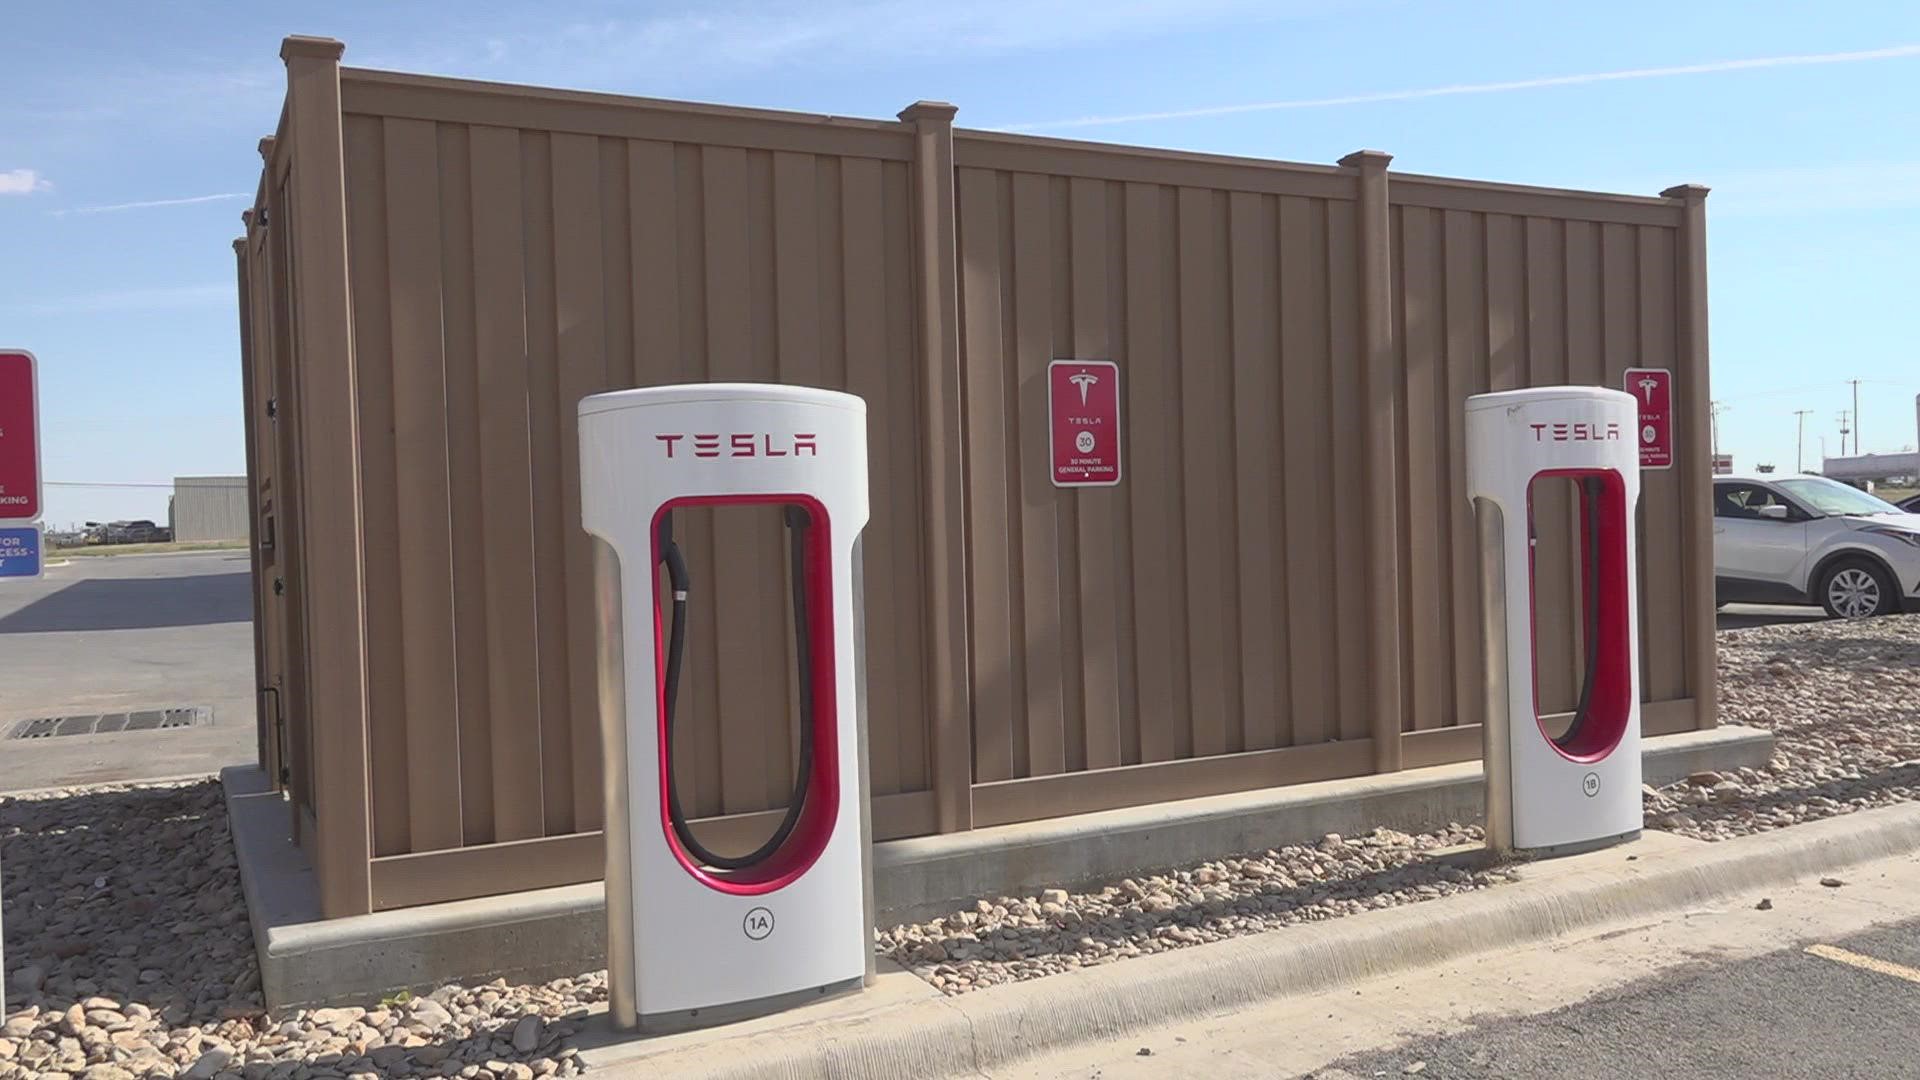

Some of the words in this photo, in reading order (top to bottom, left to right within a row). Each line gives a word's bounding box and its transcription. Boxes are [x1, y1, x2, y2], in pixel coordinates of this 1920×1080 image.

[1068, 417, 1101, 425] TESLA
[1530, 423, 1619, 441] TESLA
[655, 434, 816, 458] TESLA
[1079, 437, 1092, 448] 30
[1087, 465, 1114, 473] PARKING
[0, 496, 29, 504] KING
[1586, 779, 1597, 789] 1B
[750, 916, 769, 930] 1A
